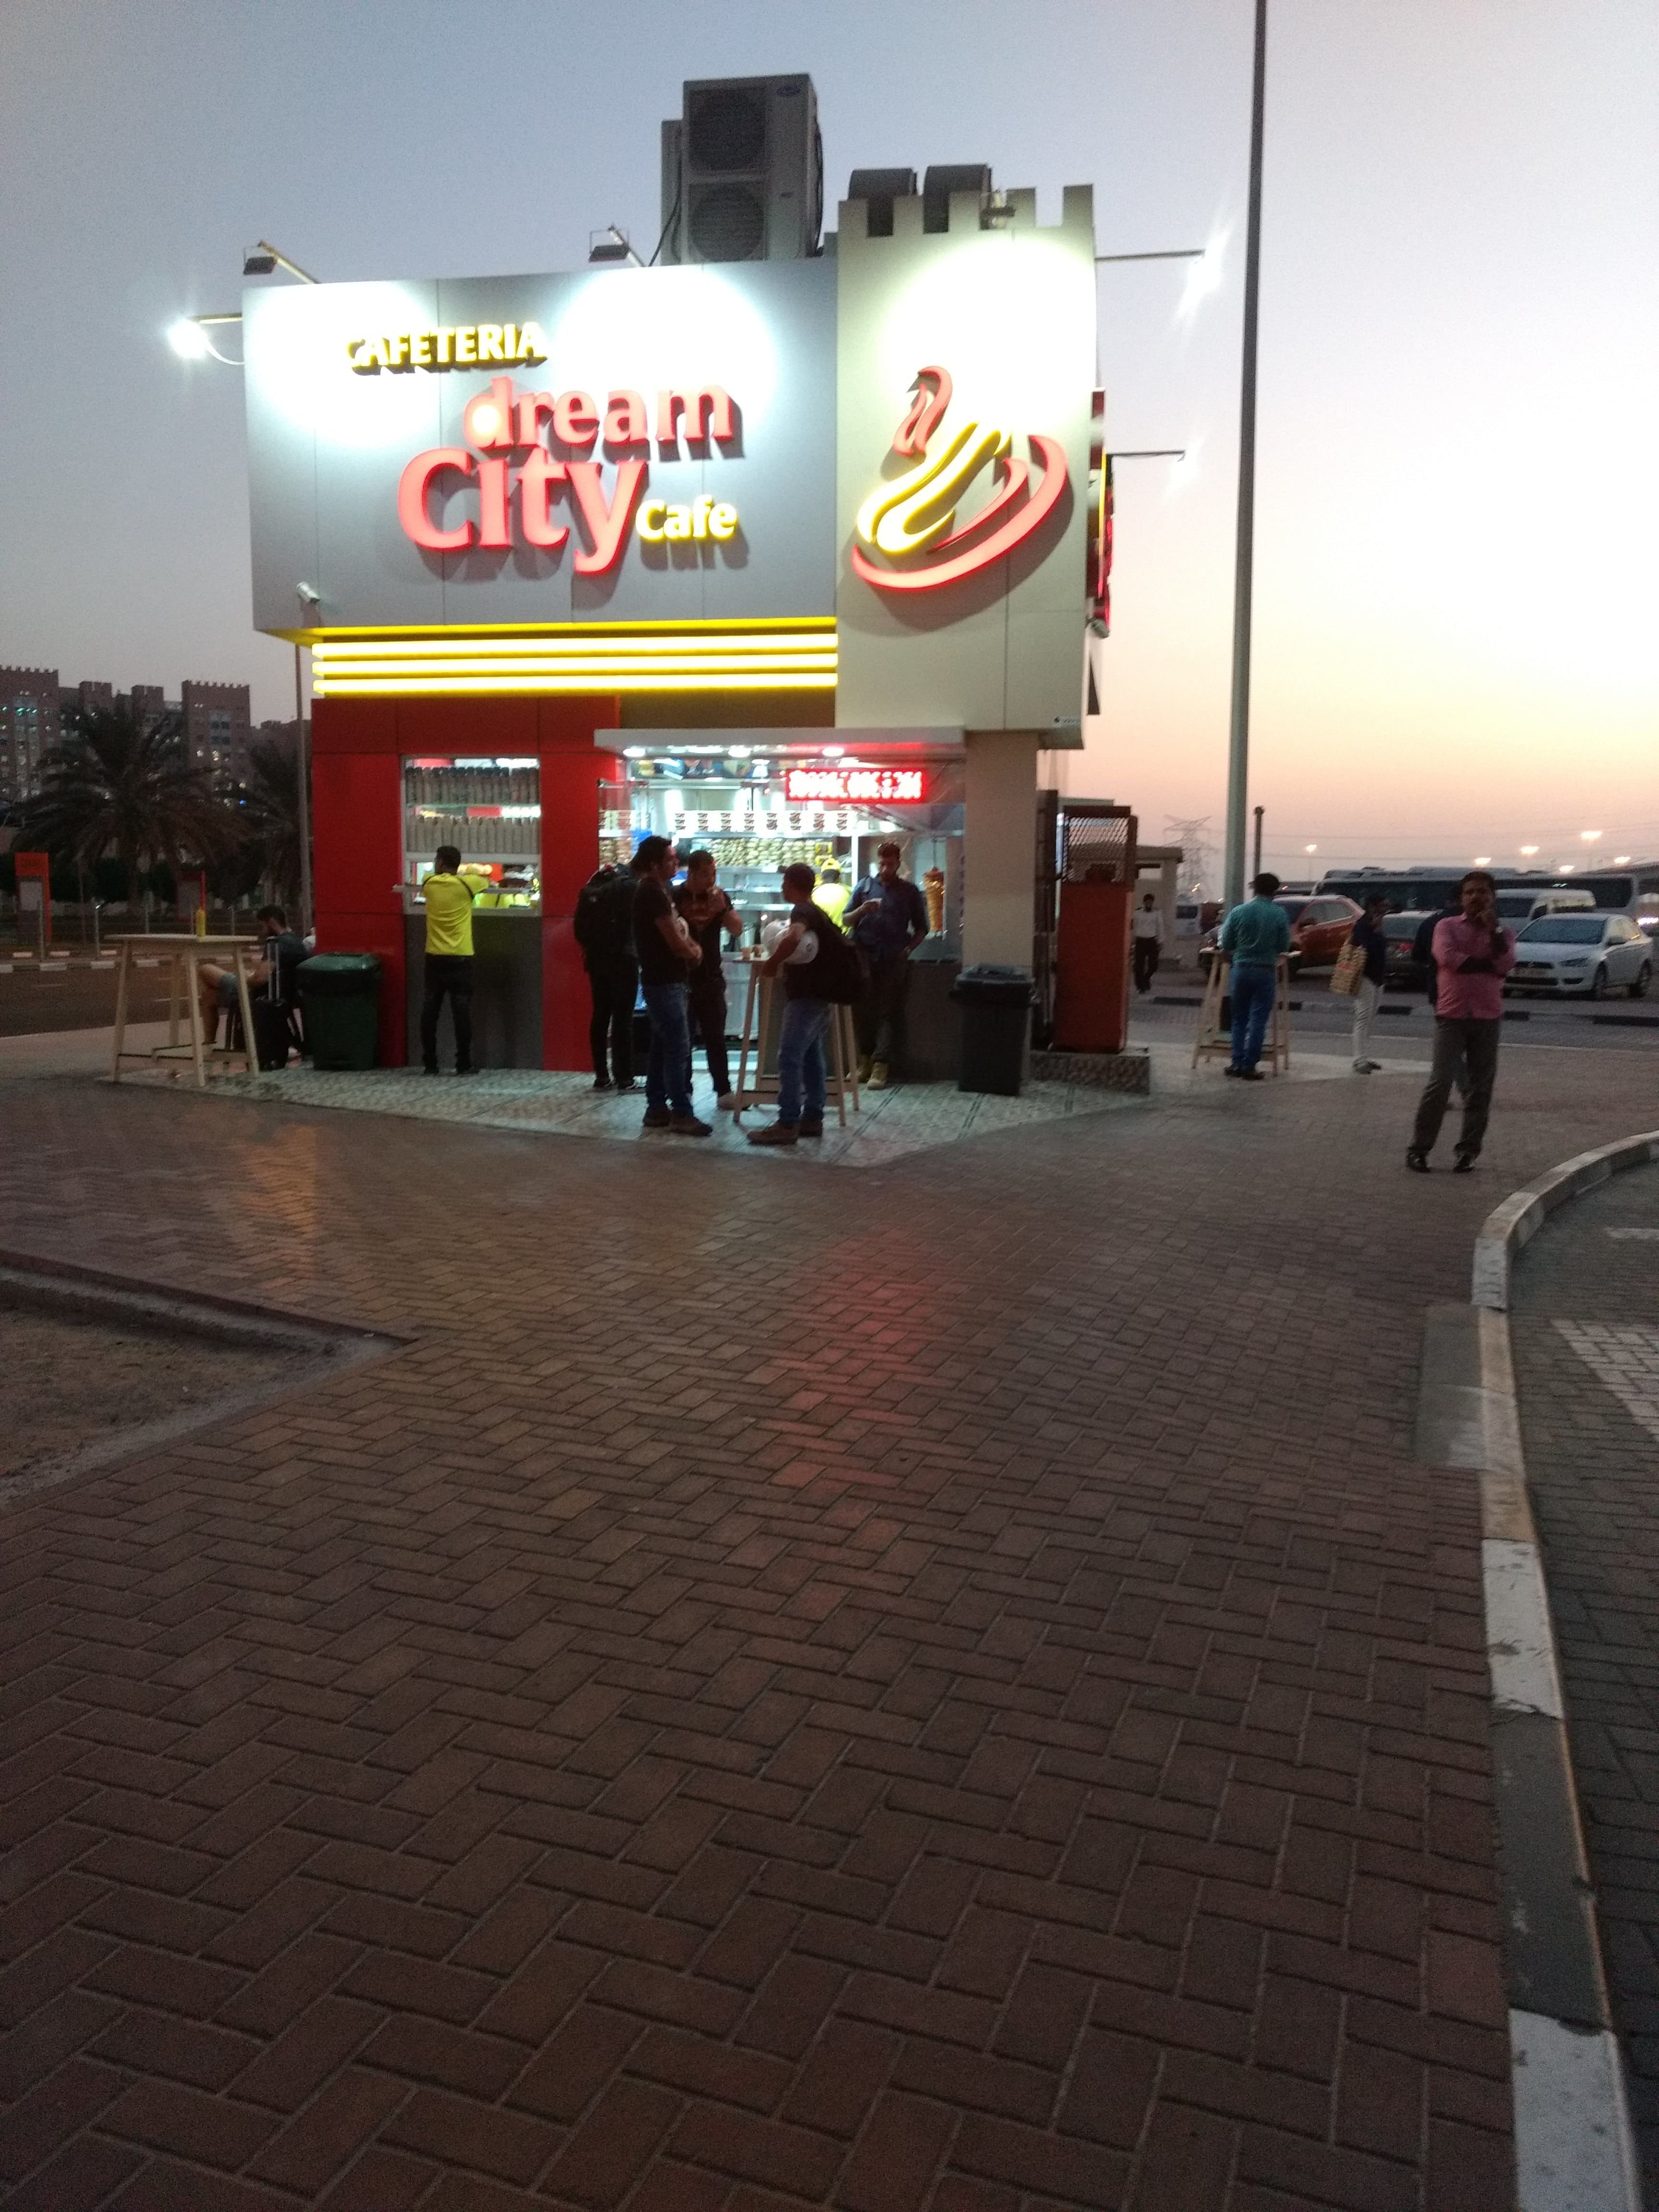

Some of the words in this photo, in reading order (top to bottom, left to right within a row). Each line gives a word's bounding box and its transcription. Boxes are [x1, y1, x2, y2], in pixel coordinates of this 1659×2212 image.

[347, 322, 546, 367] CAFETERIA
[463, 377, 733, 451] dream
[635, 494, 737, 541] Cafe
